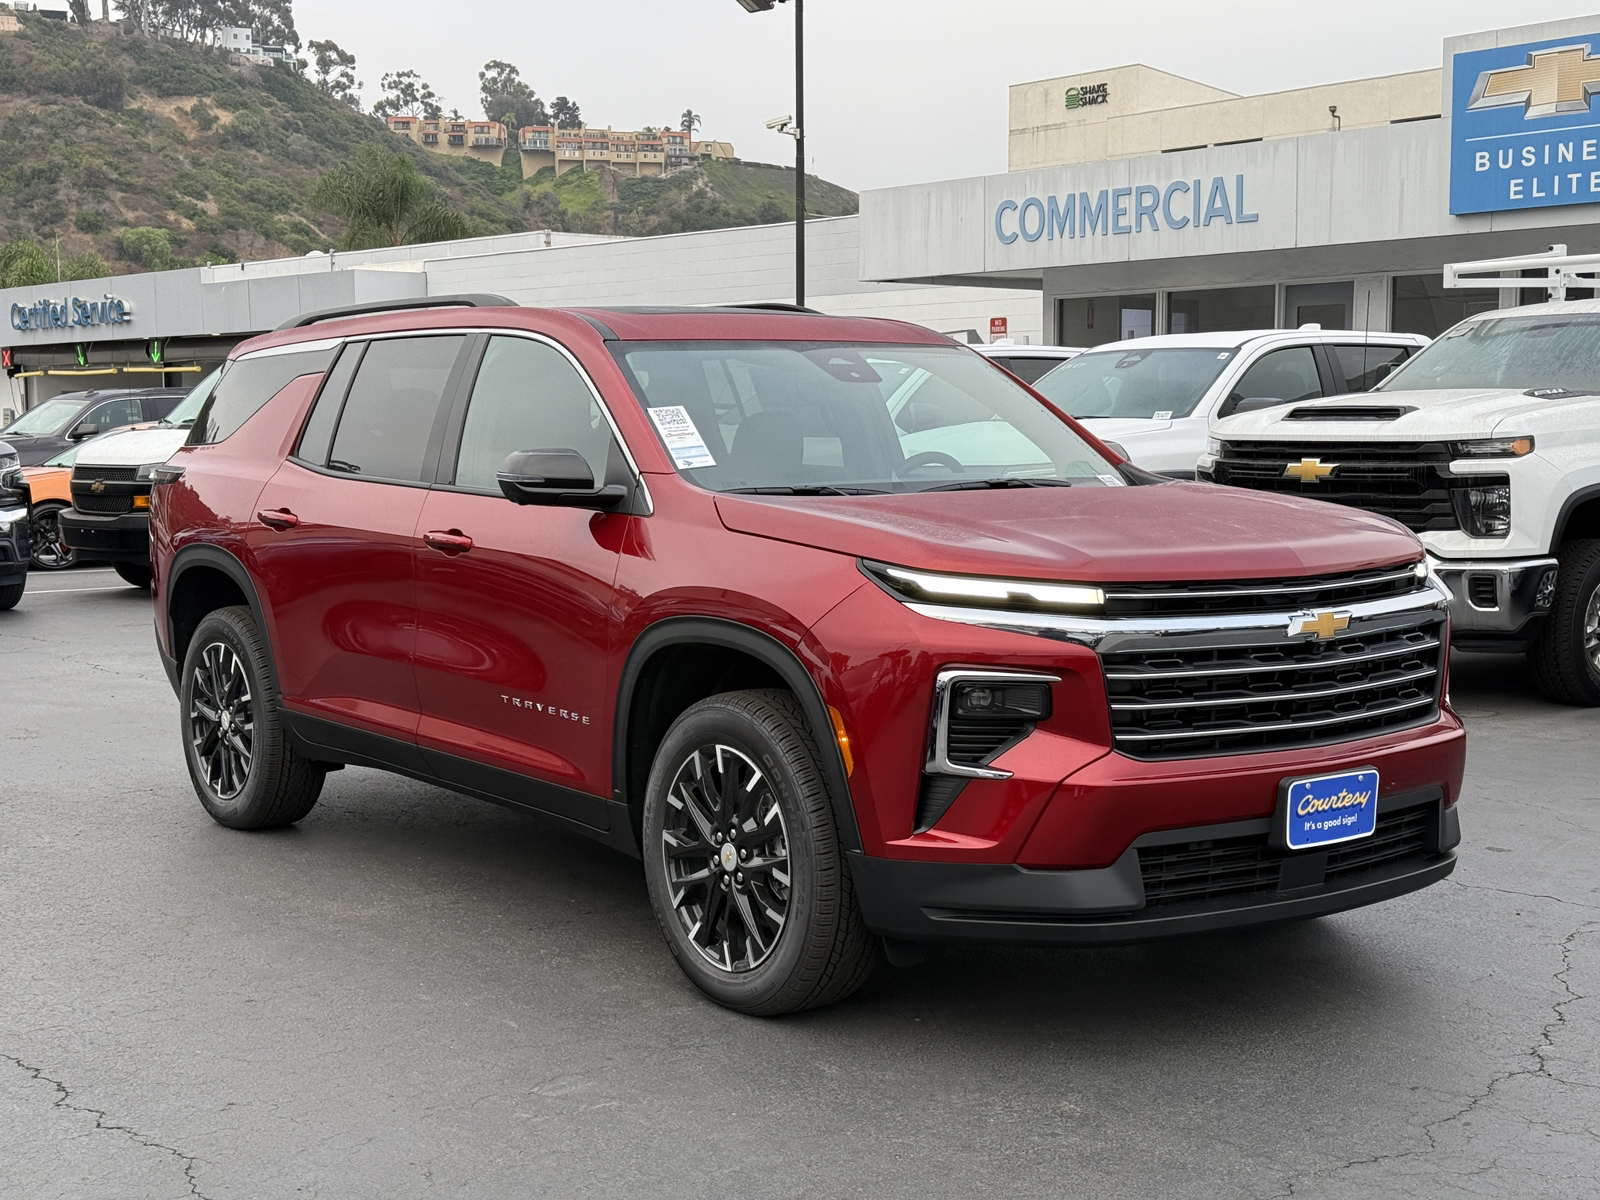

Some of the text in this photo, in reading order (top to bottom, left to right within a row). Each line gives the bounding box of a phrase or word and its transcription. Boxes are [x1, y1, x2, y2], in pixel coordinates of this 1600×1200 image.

[1080, 83, 1108, 96] SHAKE
[1080, 93, 1108, 107] SHACK
[1475, 139, 1598, 172] BUSINE
[1509, 171, 1600, 200] ELITE
[995, 174, 1259, 245] COMMERCIAL
[11, 294, 128, 330] Certified Service
[501, 694, 590, 726] TRAVERSE
[1297, 788, 1371, 815] Courtesy
[1304, 821, 1316, 831] It's
[1323, 816, 1341, 831] good
[1342, 813, 1357, 826] sign!
